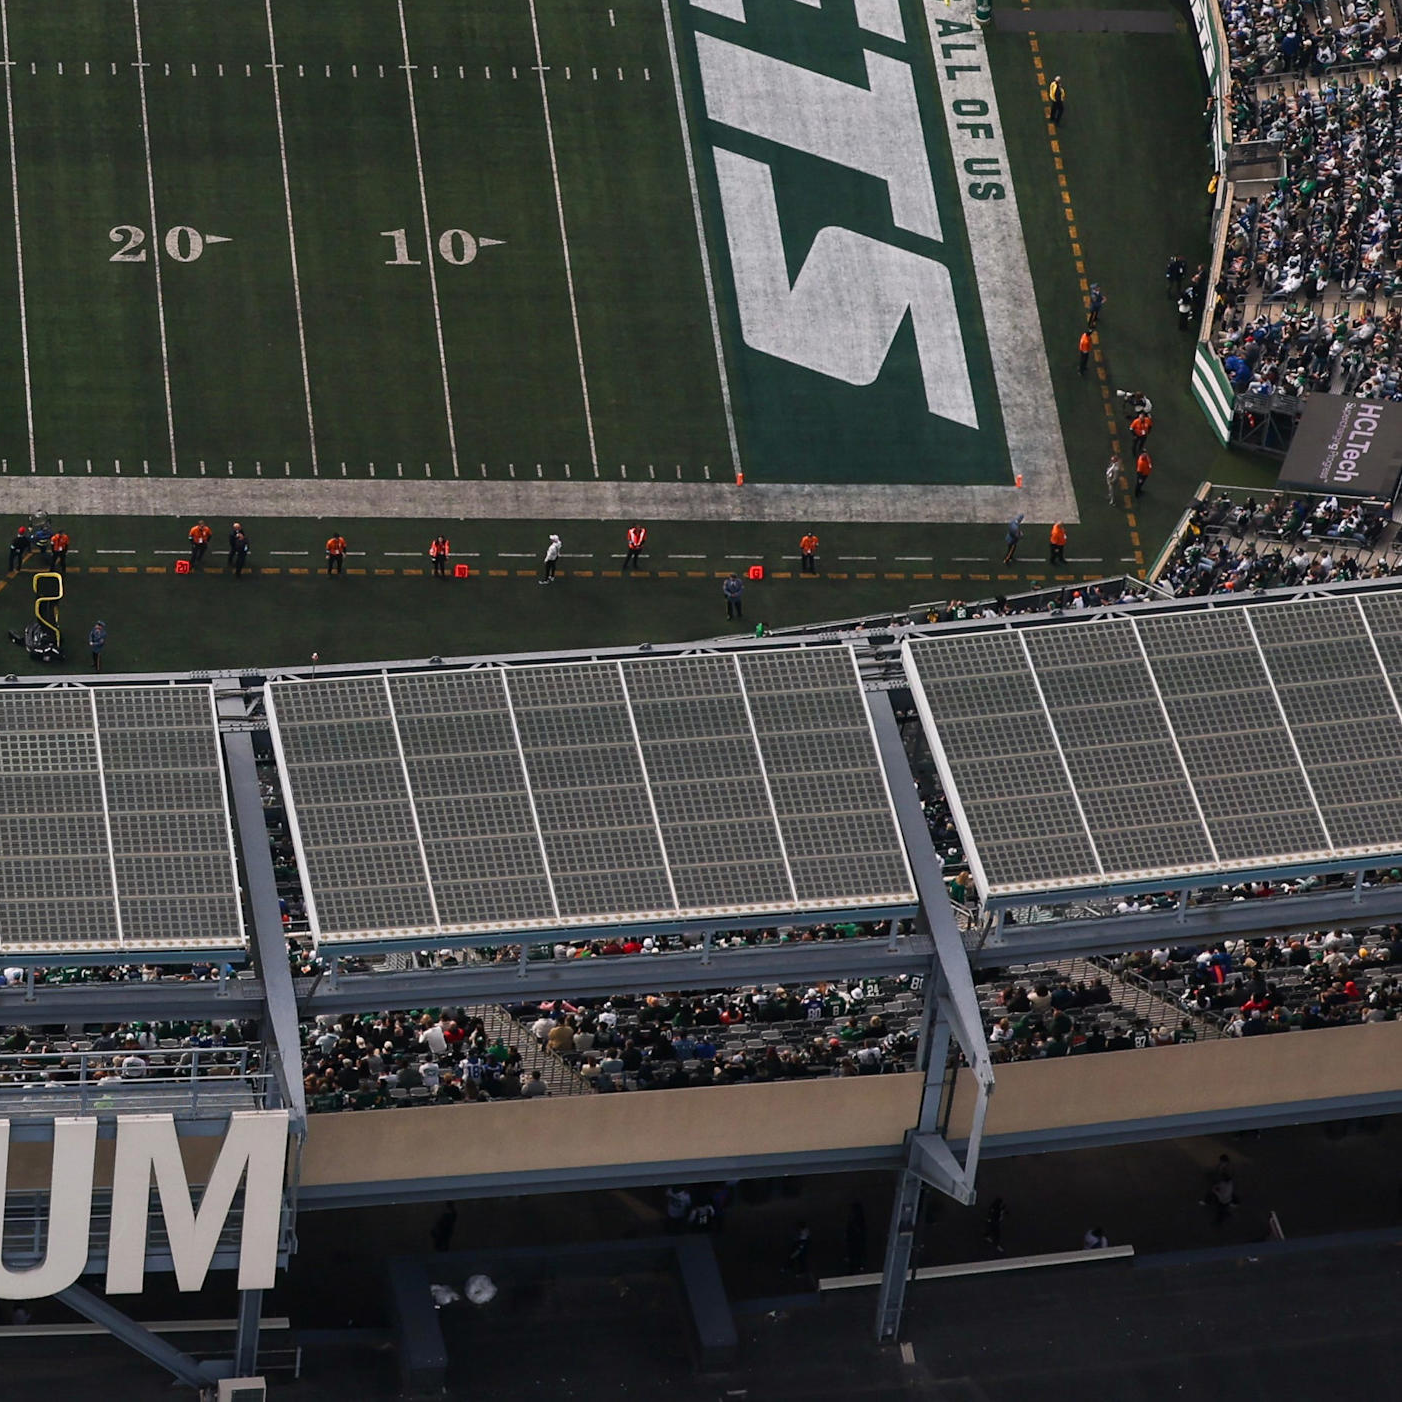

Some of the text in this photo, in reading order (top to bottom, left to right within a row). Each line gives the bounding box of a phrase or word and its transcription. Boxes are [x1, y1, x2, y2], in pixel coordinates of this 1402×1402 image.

[934, 18, 981, 81] ALL
[952, 98, 994, 140] OF
[963, 157, 1006, 201] US
[108, 225, 204, 263] 20
[381, 228, 478, 266] 10
[1333, 403, 1384, 482] HCLTech
